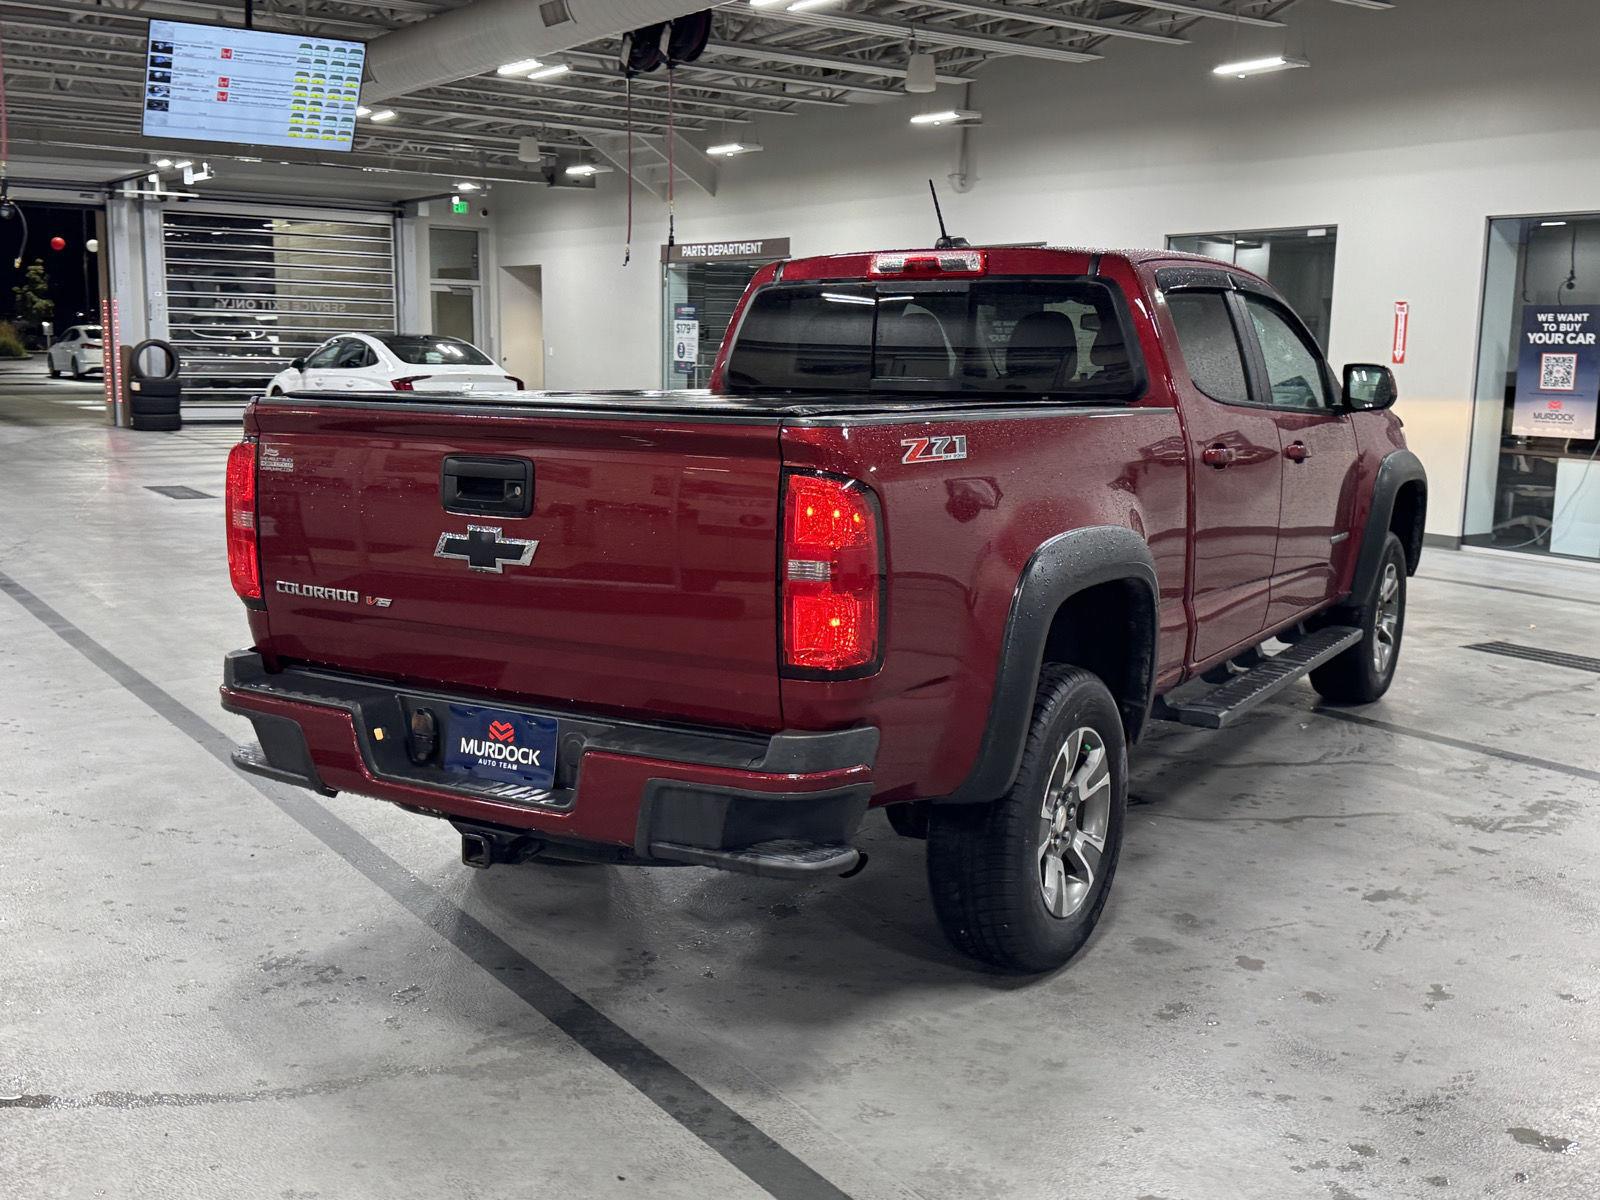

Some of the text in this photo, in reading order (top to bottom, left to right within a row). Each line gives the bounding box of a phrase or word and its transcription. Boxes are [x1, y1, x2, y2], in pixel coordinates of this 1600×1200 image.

[681, 242, 763, 257] PARTS DEPARTMENT
[1536, 313, 1590, 322] WE WANT
[1542, 323, 1581, 332] TO BUY
[1527, 333, 1596, 345] YOUR CAR
[1533, 412, 1575, 421] MURDOCK
[901, 435, 967, 464] Z71
[276, 580, 393, 608] COLORADO V6
[460, 737, 541, 766] MURDOCK
[478, 758, 518, 770] AUTO TEAM
